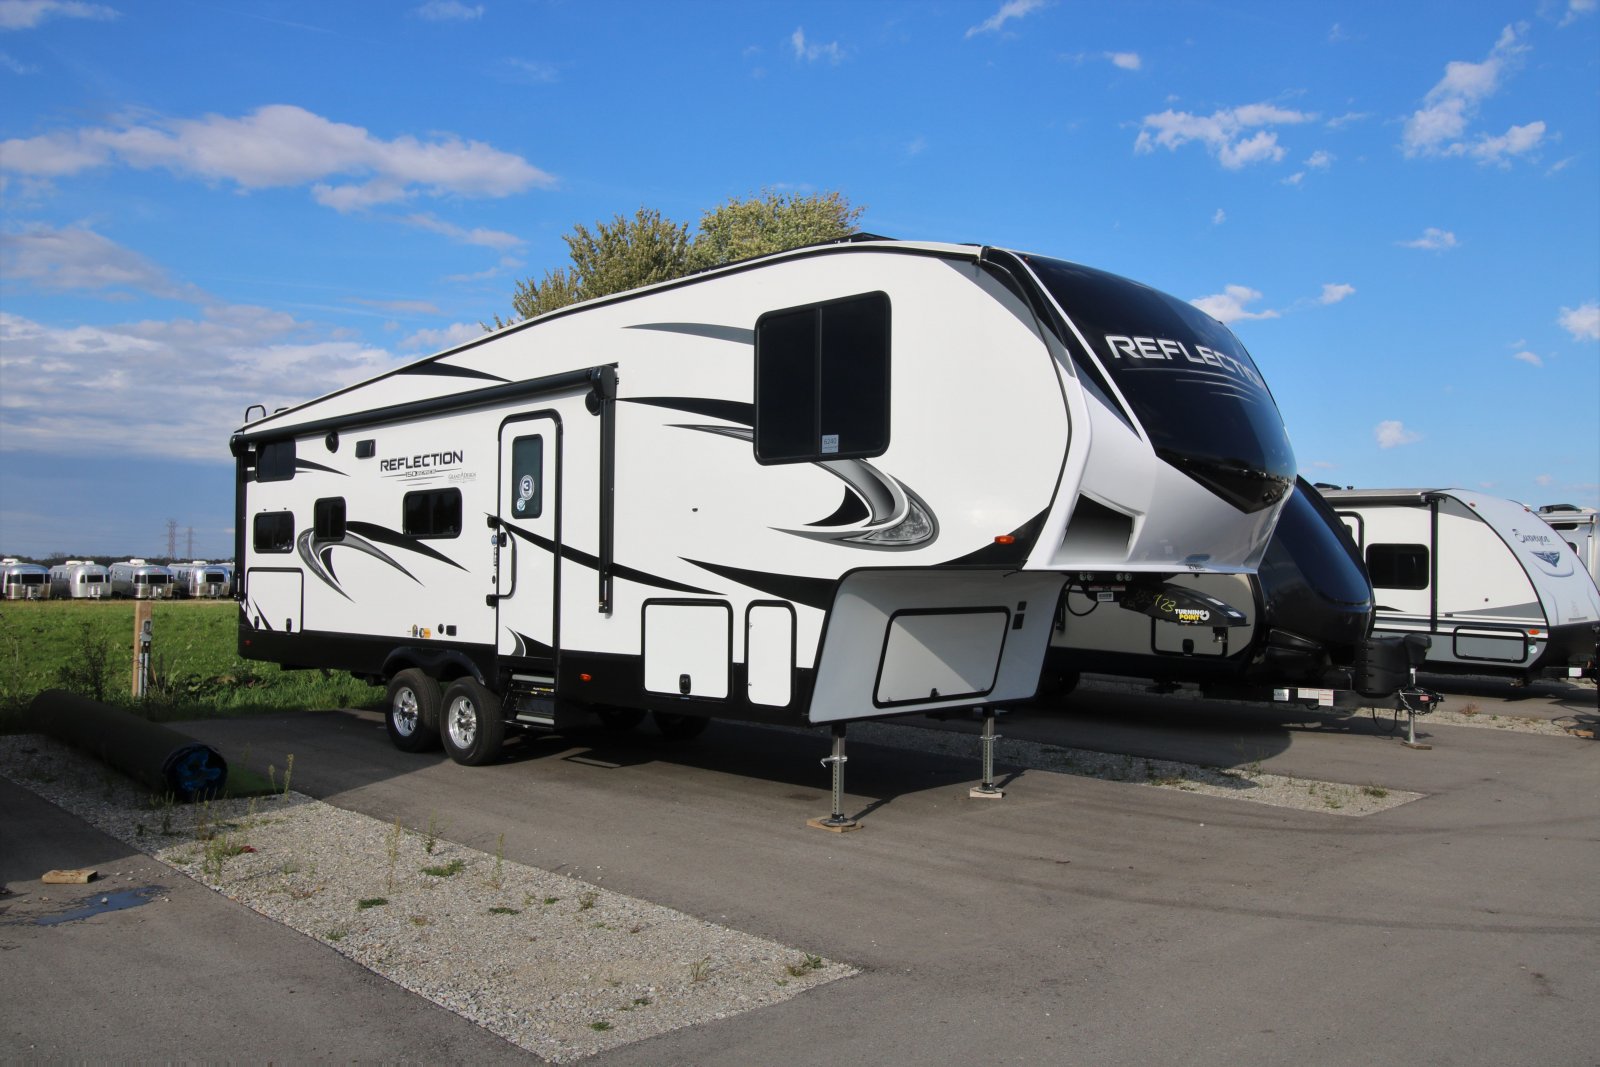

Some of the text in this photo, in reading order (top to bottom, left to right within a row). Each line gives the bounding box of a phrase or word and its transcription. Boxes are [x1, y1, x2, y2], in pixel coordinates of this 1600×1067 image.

[380, 450, 463, 472] REFLECTION
[523, 480, 531, 492] 3
[1174, 608, 1204, 616] TURNING
